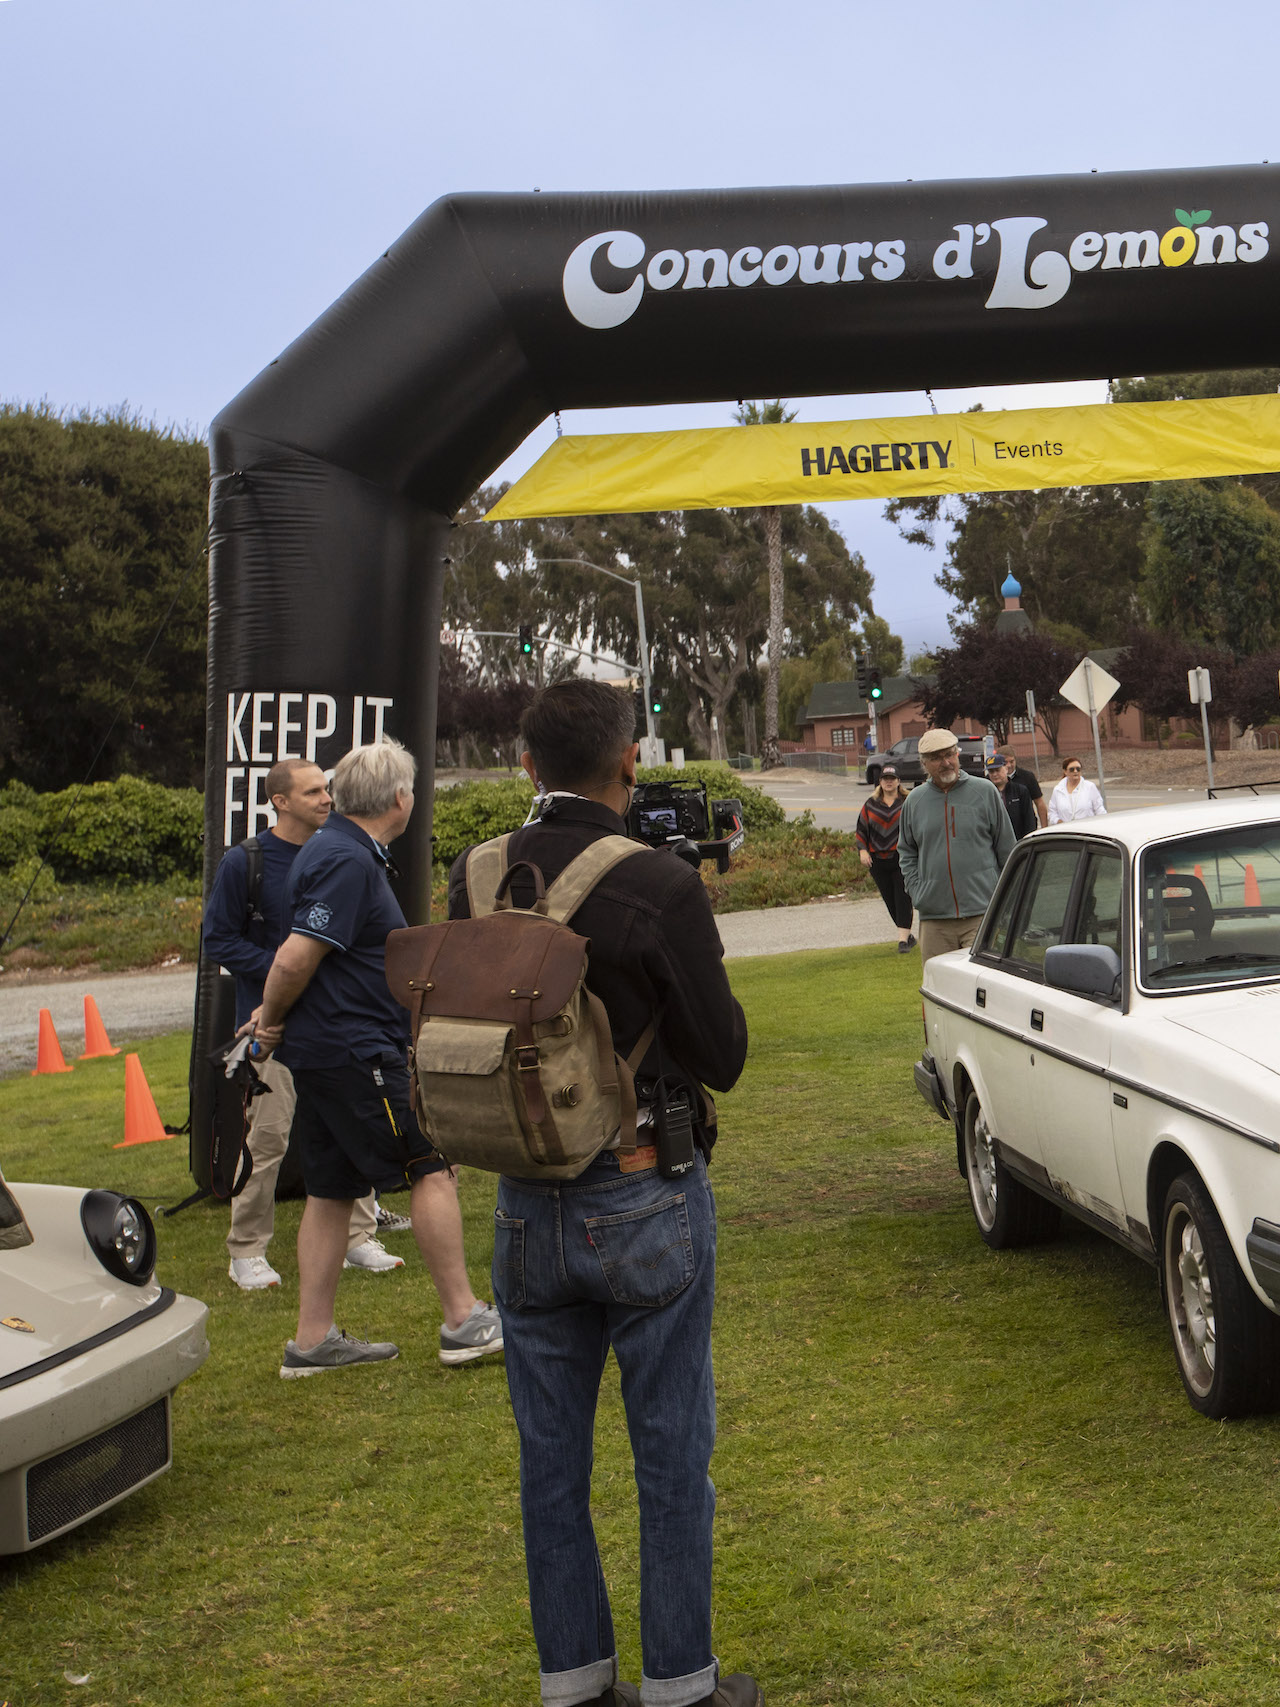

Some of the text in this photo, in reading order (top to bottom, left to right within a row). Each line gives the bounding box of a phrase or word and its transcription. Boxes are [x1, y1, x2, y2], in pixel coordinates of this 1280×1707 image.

[562, 230, 906, 330] Concours
[801, 439, 1064, 476] HAGERTY Events
[227, 692, 393, 762] KEEP IT
